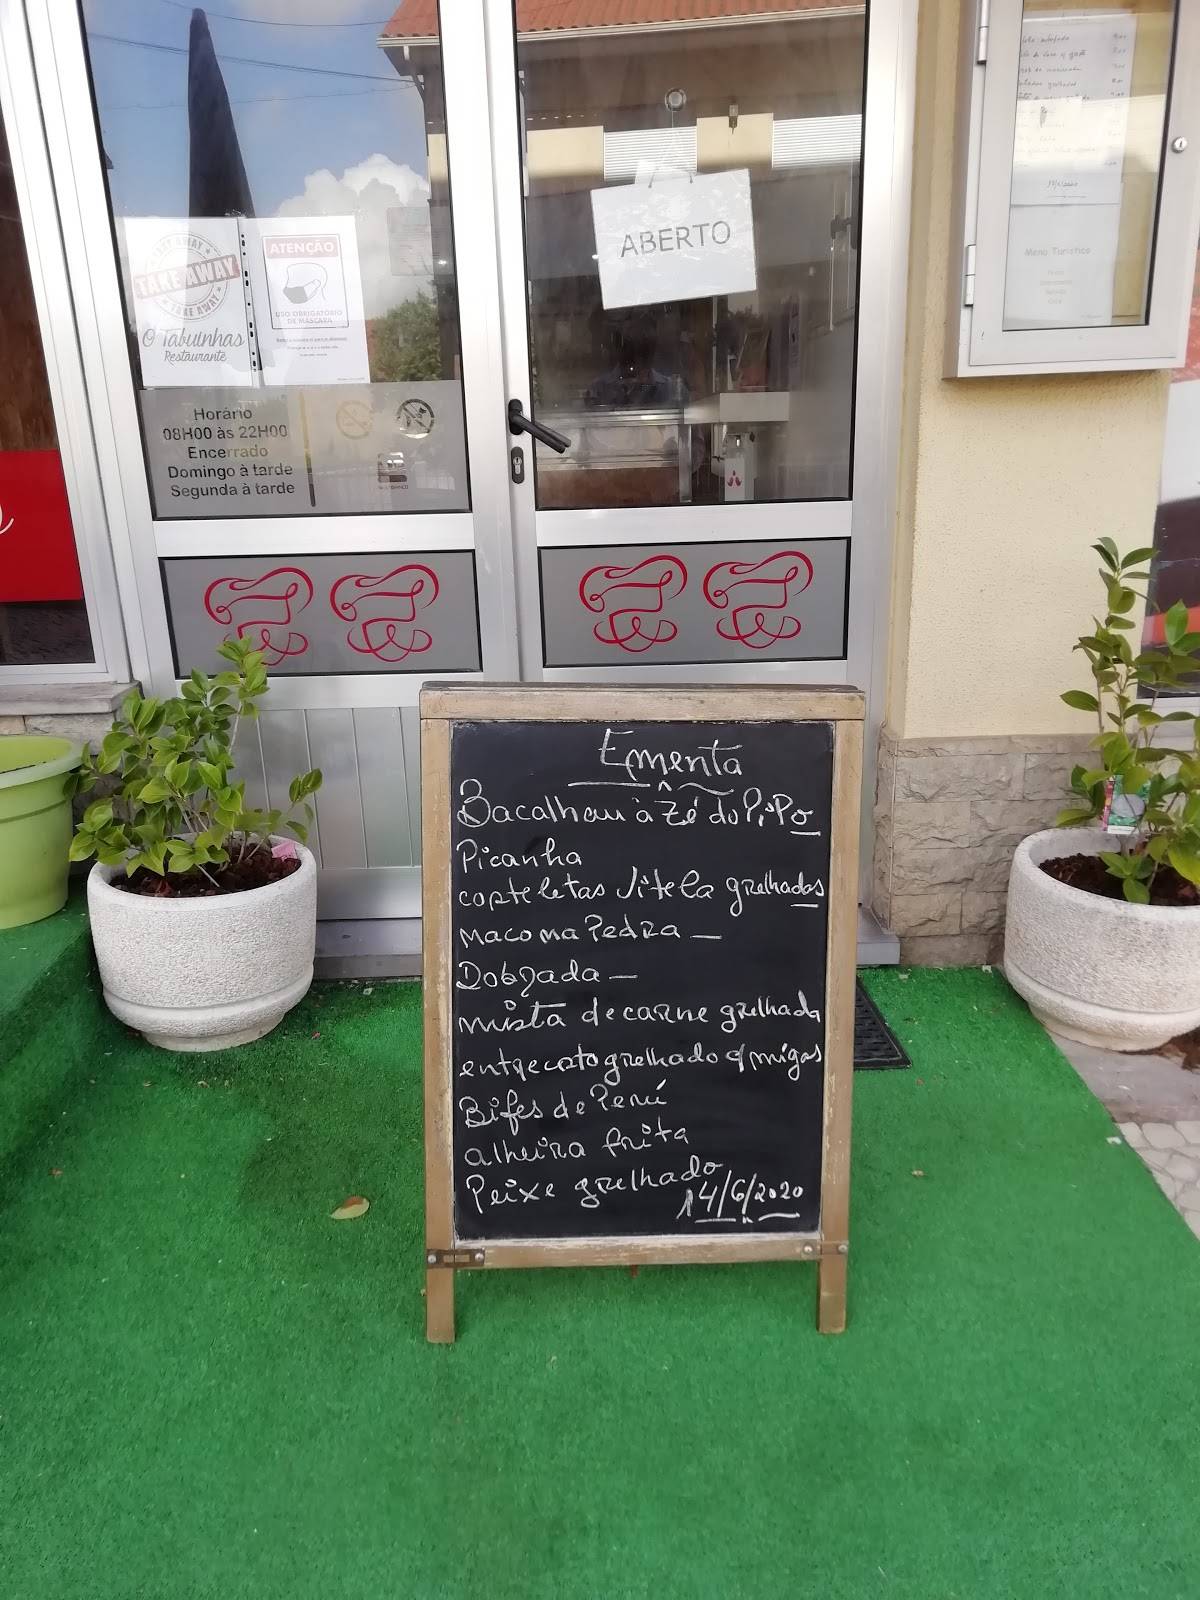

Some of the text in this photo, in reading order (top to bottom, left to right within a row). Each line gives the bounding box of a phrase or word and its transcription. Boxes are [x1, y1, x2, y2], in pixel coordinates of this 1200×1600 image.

[269, 239, 335, 255] ATENÇÃO
[620, 219, 732, 259] ABERTO
[137, 257, 234, 298] TAKE AWAY
[196, 293, 220, 317] AWAY
[275, 310, 291, 318] USO
[142, 328, 156, 348] O
[164, 350, 227, 368] Restaurante
[193, 407, 252, 420] Horário
[162, 424, 288, 441] 08H00 às 22H00
[188, 445, 269, 459] Encerrado
[168, 463, 293, 480] Domingo à tarde
[171, 481, 295, 499] Segunda à tarde
[598, 728, 743, 781] Ementa
[456, 778, 627, 828] Bacalhau
[708, 796, 739, 825] do
[456, 837, 582, 874] Picanha
[581, 997, 615, 1027] de
[459, 1089, 544, 1136] Bifes
[553, 1091, 586, 1120] de
[466, 1154, 724, 1214] Peixe grelhado
